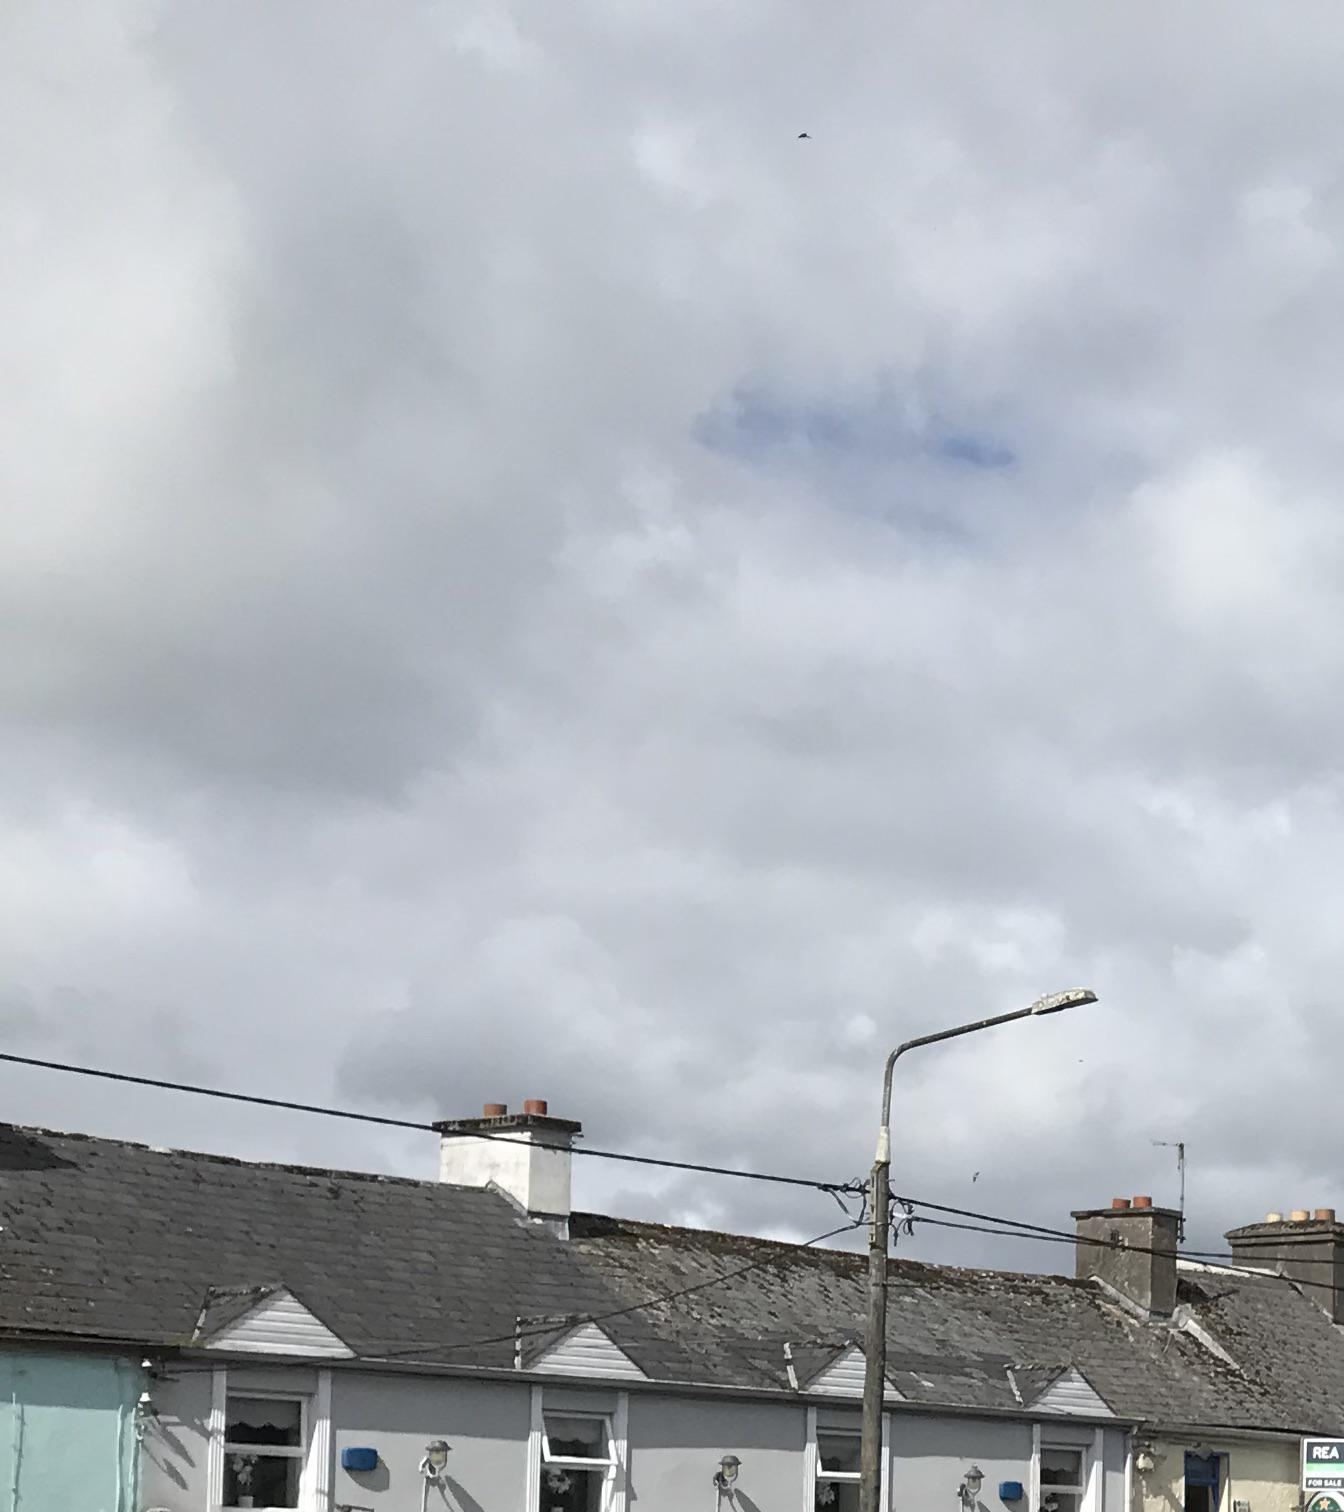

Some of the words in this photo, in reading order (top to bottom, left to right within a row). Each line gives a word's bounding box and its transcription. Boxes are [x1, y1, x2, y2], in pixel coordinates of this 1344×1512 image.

[1312, 1446, 1340, 1459] REA
[1307, 1479, 1323, 1487] FOR
[1323, 1479, 1343, 1487] SALE
